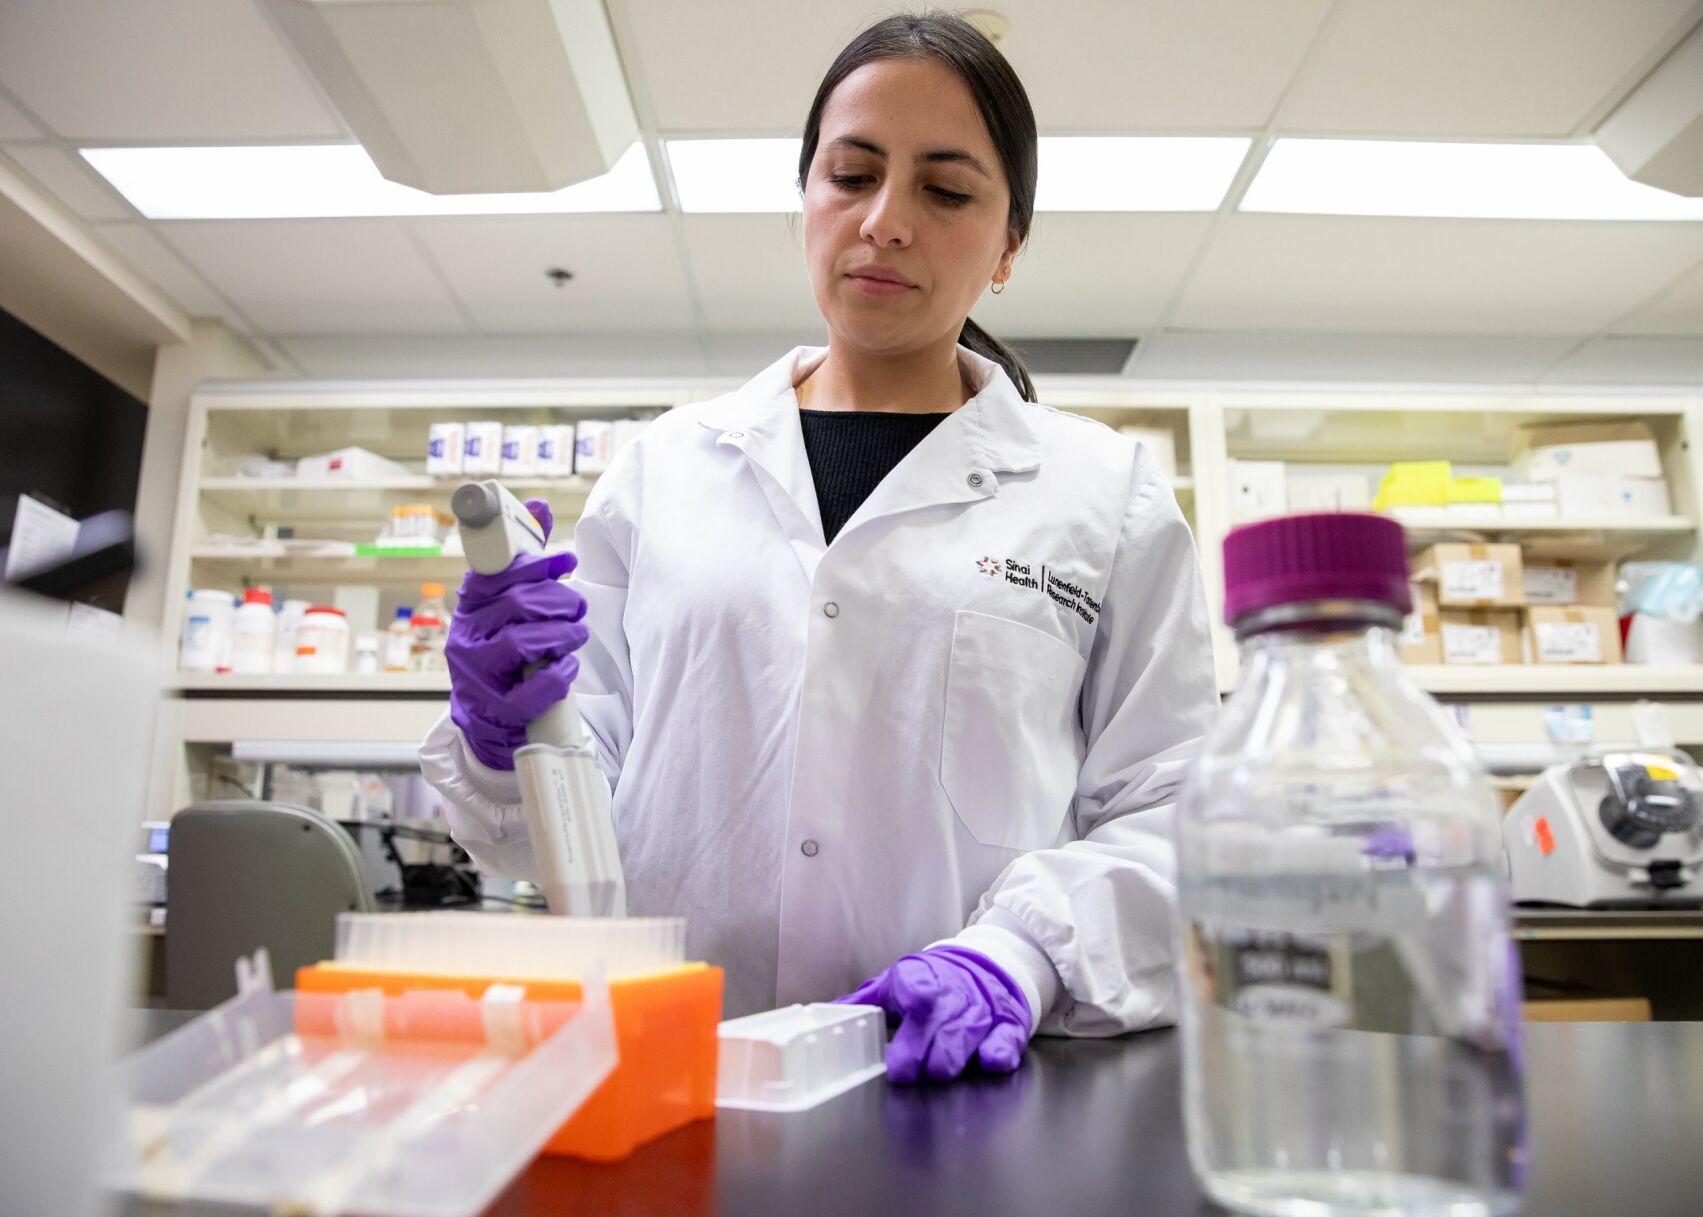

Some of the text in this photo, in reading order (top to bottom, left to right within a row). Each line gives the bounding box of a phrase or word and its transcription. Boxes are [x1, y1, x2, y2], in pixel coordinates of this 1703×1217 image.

[1005, 558, 1031, 575] Sinai
[1005, 571, 1038, 590] Health
[1047, 570, 1101, 614] Lunenfeld-Tanenb
[1046, 583, 1076, 610] Research
